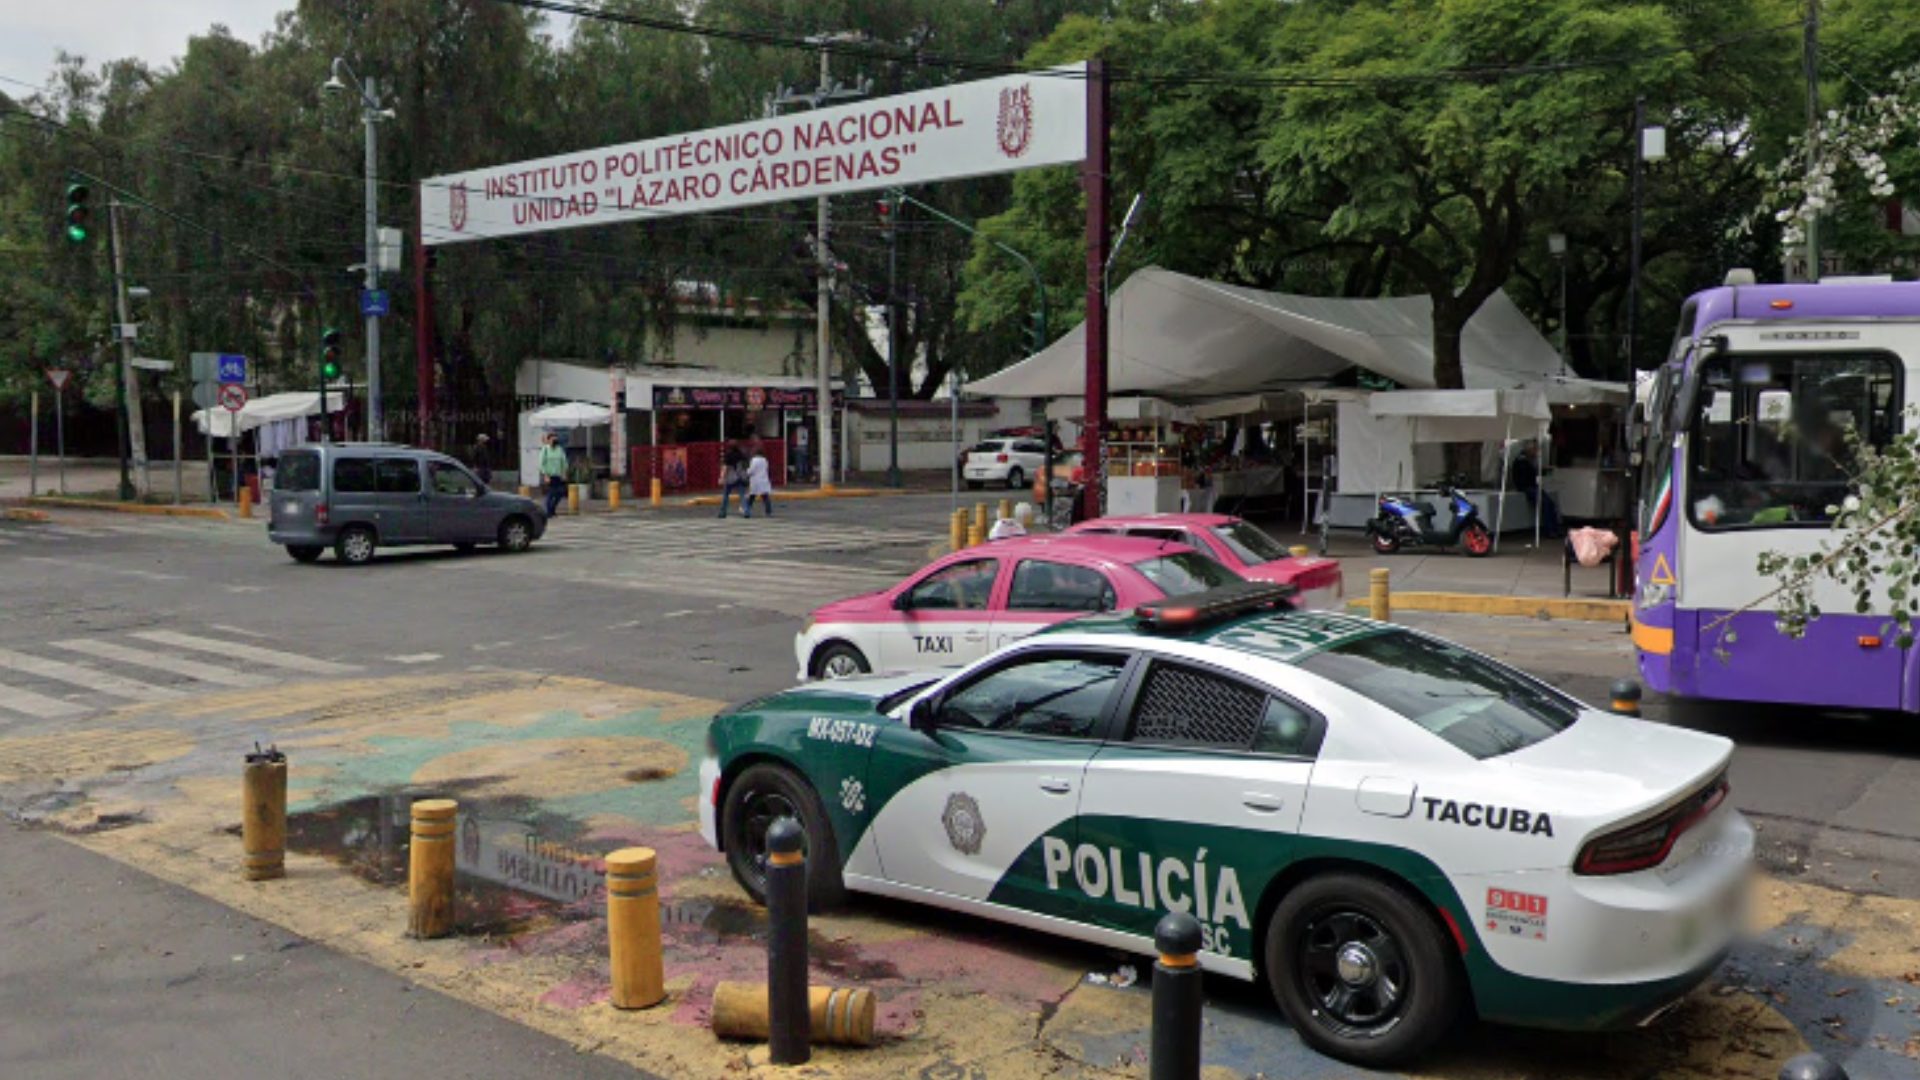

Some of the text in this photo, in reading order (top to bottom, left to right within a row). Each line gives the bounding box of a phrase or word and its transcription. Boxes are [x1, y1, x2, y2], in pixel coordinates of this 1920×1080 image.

[484, 98, 963, 200] INSTITUTO POLITÉCNICO NACIONAL
[513, 142, 917, 225] UNIDAD "LÁZARO CÁRDENAS"
[913, 635, 953, 653] TAXI
[1422, 796, 1554, 838] TACUBA
[1043, 836, 1250, 930] POLICÍA
[1489, 889, 1545, 914] 911
[1201, 922, 1232, 956] SC
